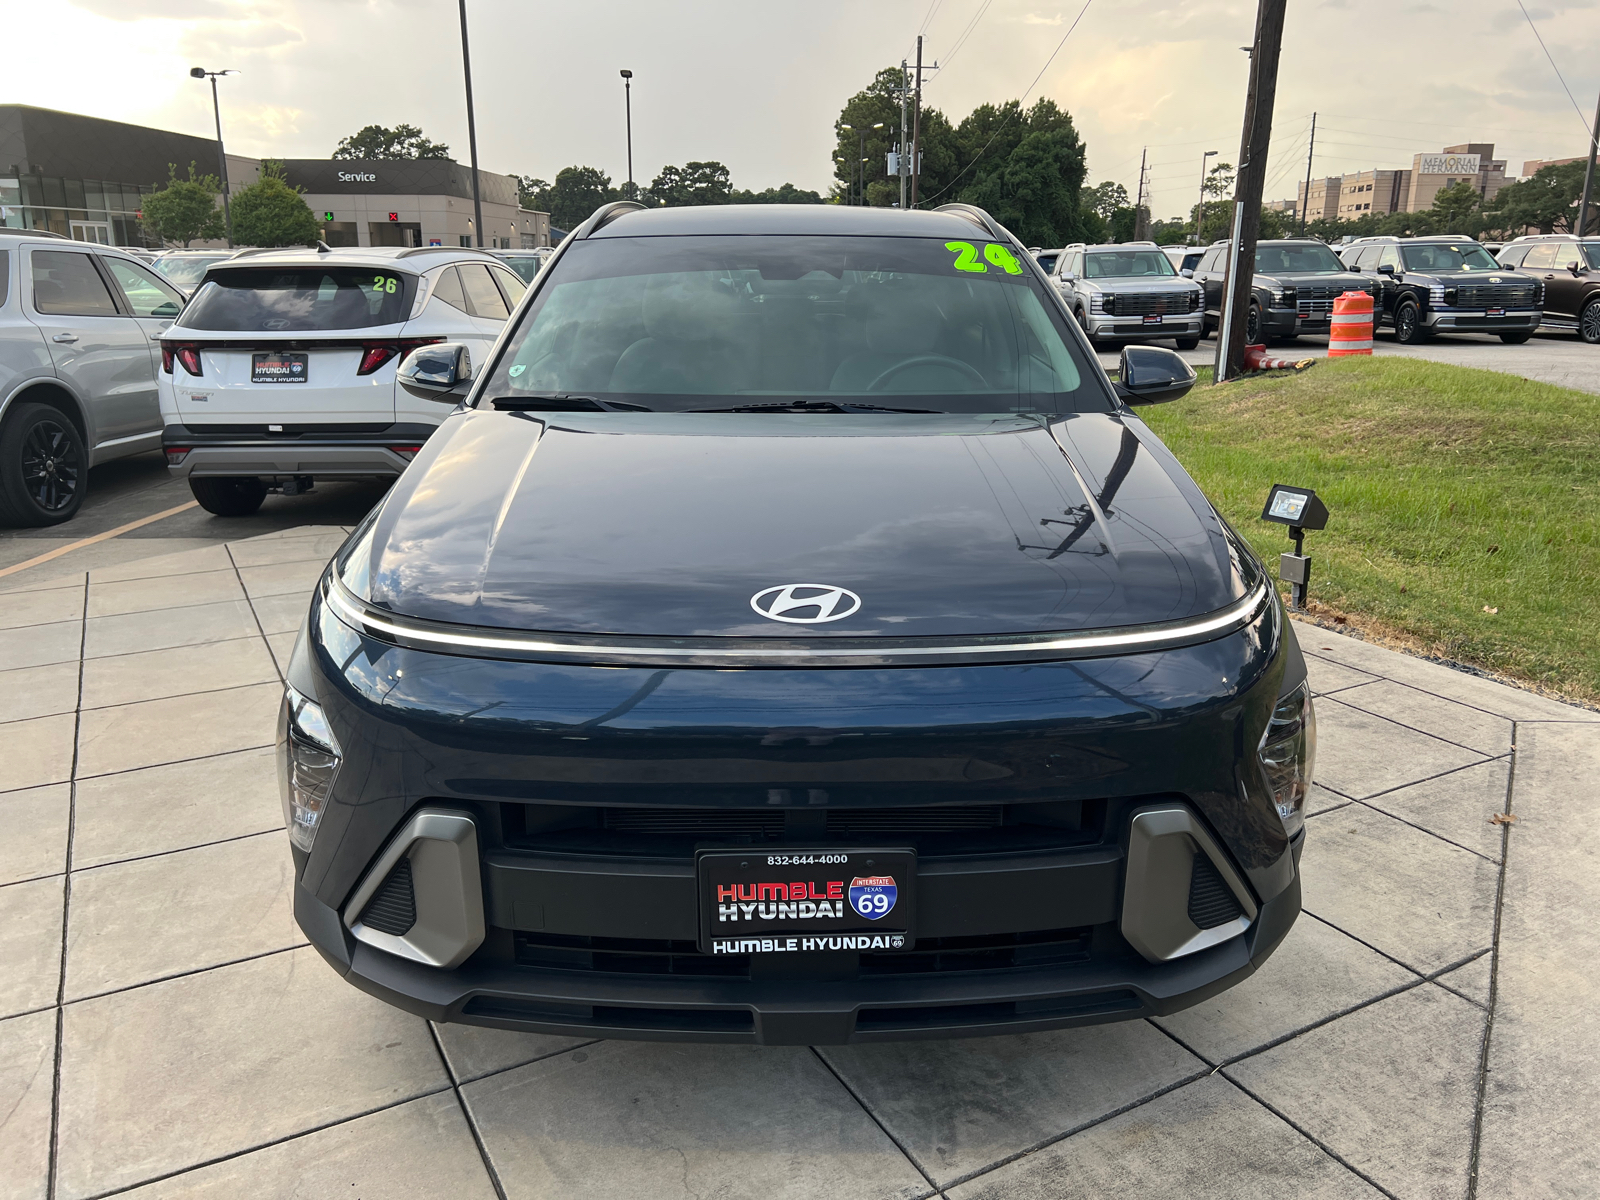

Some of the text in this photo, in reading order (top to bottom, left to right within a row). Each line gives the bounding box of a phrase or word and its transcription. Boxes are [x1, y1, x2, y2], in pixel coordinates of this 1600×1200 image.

[1422, 165, 1477, 174] HERMANN
[1423, 157, 1478, 166] MEMORIAL
[338, 171, 376, 182] Service
[944, 241, 1024, 276] 24
[372, 275, 397, 294] 26
[767, 855, 848, 866] 832-644-4000
[717, 881, 844, 902] HUMBLE
[856, 878, 890, 886] INTERSTATE
[718, 900, 844, 922] HYUNDAI
[857, 894, 889, 914] 69
[713, 935, 890, 954] HUMBLE HYUNDAI
